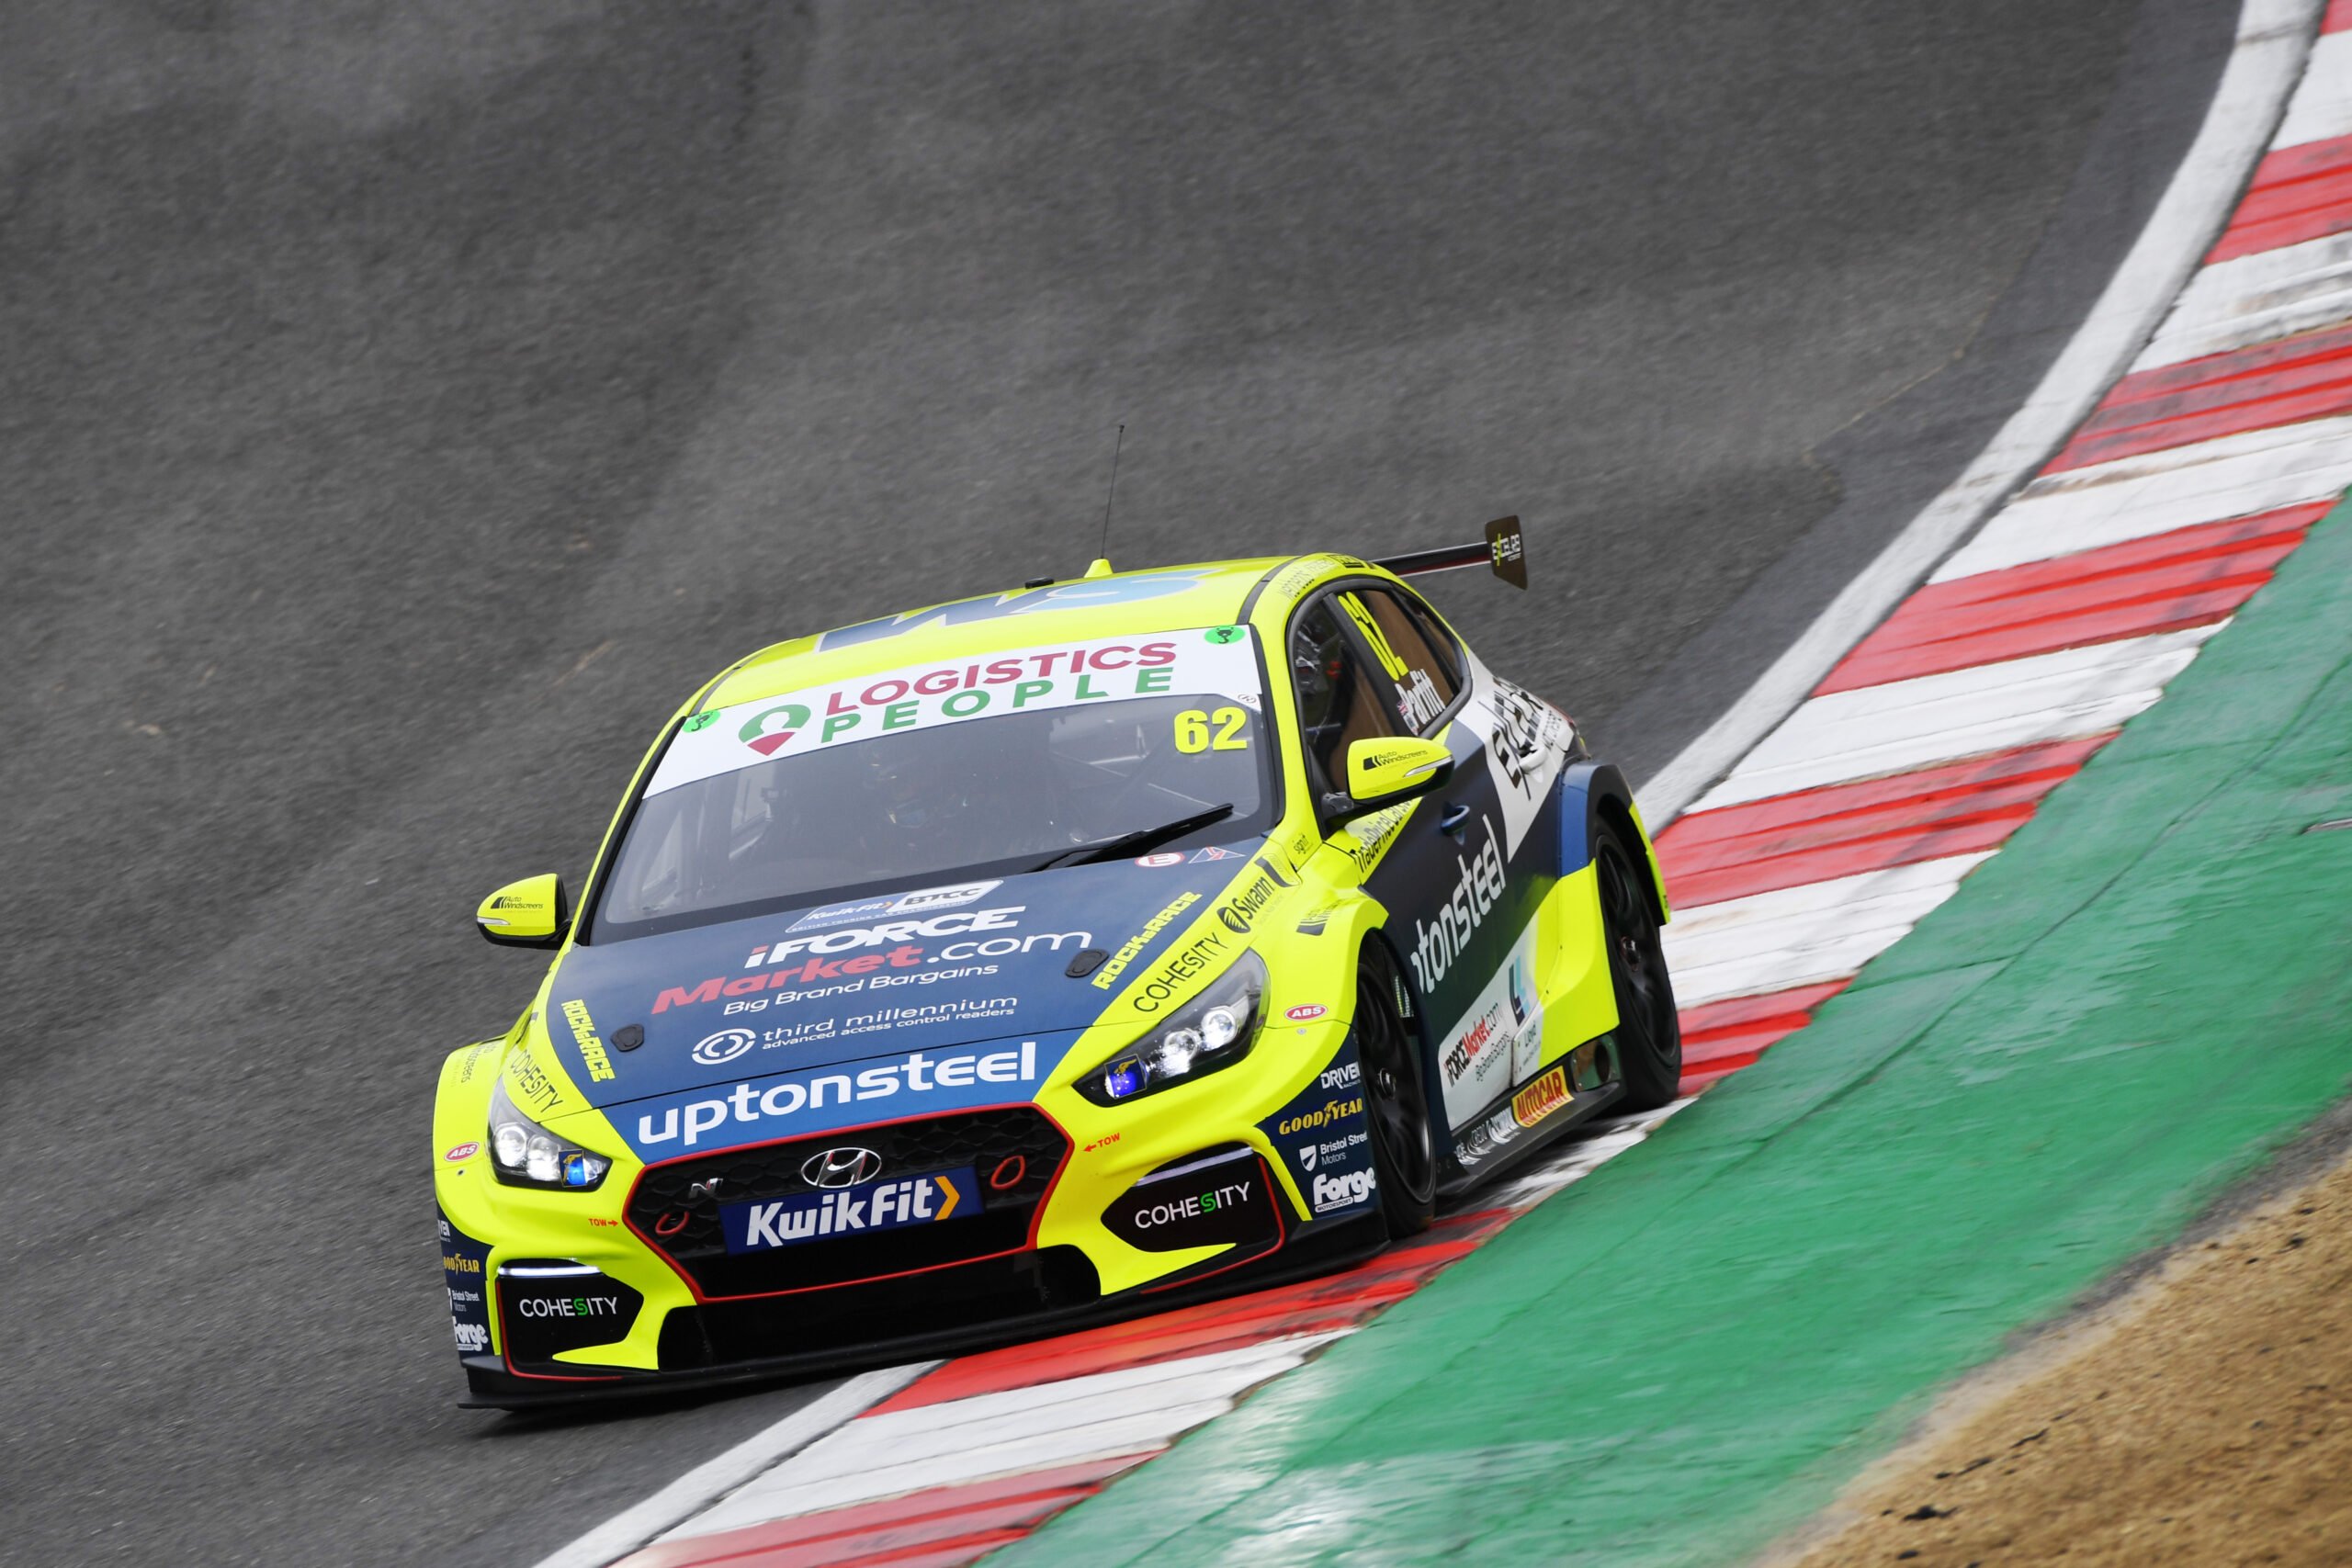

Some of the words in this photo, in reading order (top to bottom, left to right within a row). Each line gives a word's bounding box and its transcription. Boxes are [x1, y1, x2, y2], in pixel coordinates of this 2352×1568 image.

[1337, 591, 1409, 682] 62
[826, 642, 1178, 715] LOGISTICS
[820, 666, 1174, 743] PEOPLE
[1173, 706, 1249, 753] 62
[904, 887, 982, 906] BTCC
[1232, 876, 1275, 919] Swann
[744, 906, 1026, 969] iFORCE
[723, 999, 768, 1016] Big
[775, 982, 862, 1006] Brand
[869, 964, 1000, 990] Bargains
[1133, 932, 1228, 1012] COHESITY
[762, 1018, 835, 1042] third
[845, 994, 1018, 1027] millennium
[762, 1030, 839, 1050] advanced
[840, 1022, 891, 1038] access
[892, 1014, 945, 1031] control
[947, 1007, 1015, 1023] readers
[1291, 1007, 1323, 1018] ABS
[510, 1049, 563, 1113] COHESITY
[637, 1041, 1037, 1146] uptonsteel
[1516, 1070, 1570, 1127] AUTOCAR
[1278, 1098, 1363, 1135] GOODYEAR
[450, 1145, 476, 1157] ABS
[1097, 1132, 1121, 1147] TOW
[1320, 1137, 1348, 1156] Bristol
[1321, 1151, 1347, 1167] Motors
[588, 1218, 607, 1227] TOW
[746, 1191, 860, 1248] Kwik
[869, 1178, 933, 1227] Fit
[1134, 1181, 1251, 1230] COHESITY
[1317, 1198, 1352, 1212] MOTORSPORT
[443, 1255, 481, 1273] OODYEAR
[518, 1296, 618, 1318] COHESITY
